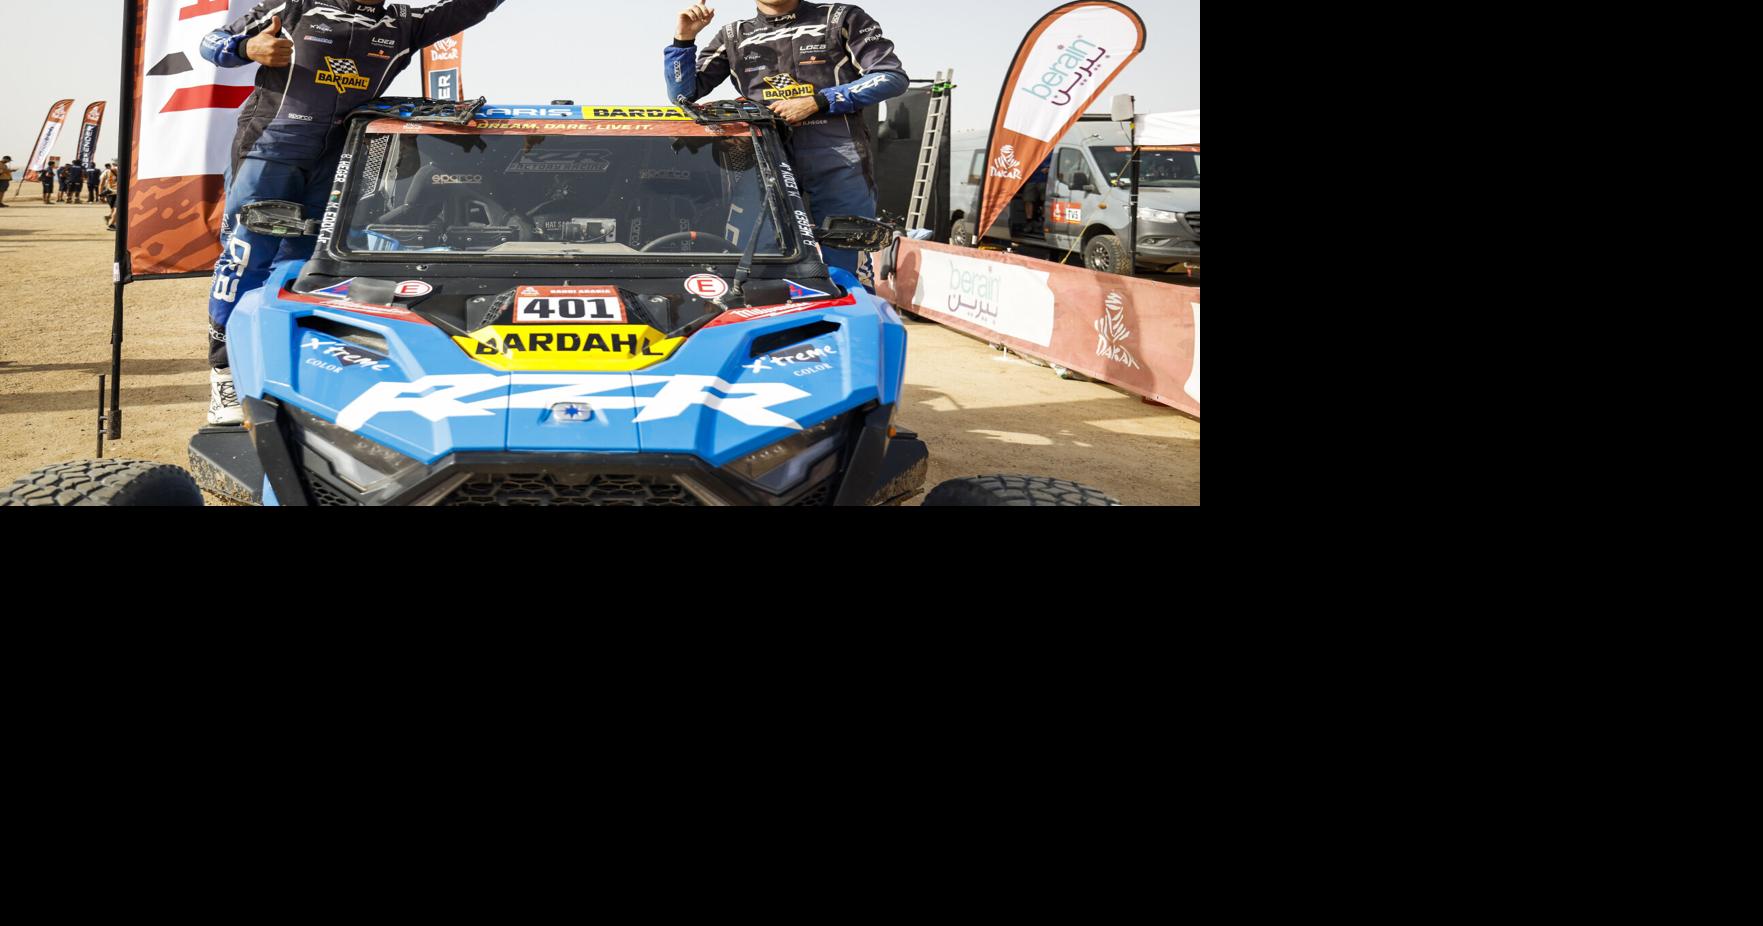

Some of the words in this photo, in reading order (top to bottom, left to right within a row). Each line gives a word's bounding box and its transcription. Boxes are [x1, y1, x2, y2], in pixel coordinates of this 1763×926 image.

[1022, 39, 1097, 100] berain
[318, 73, 367, 88] BARDAHL
[765, 86, 812, 98] BARDAHL
[475, 108, 573, 117] ARIS
[401, 284, 420, 294] E
[697, 279, 716, 293] E
[949, 259, 1001, 303] berain
[523, 298, 615, 319] 401
[475, 333, 664, 356] BARDAHL
[305, 357, 344, 374] COLOR
[793, 362, 833, 377] COLOR
[335, 373, 811, 432] RZR
